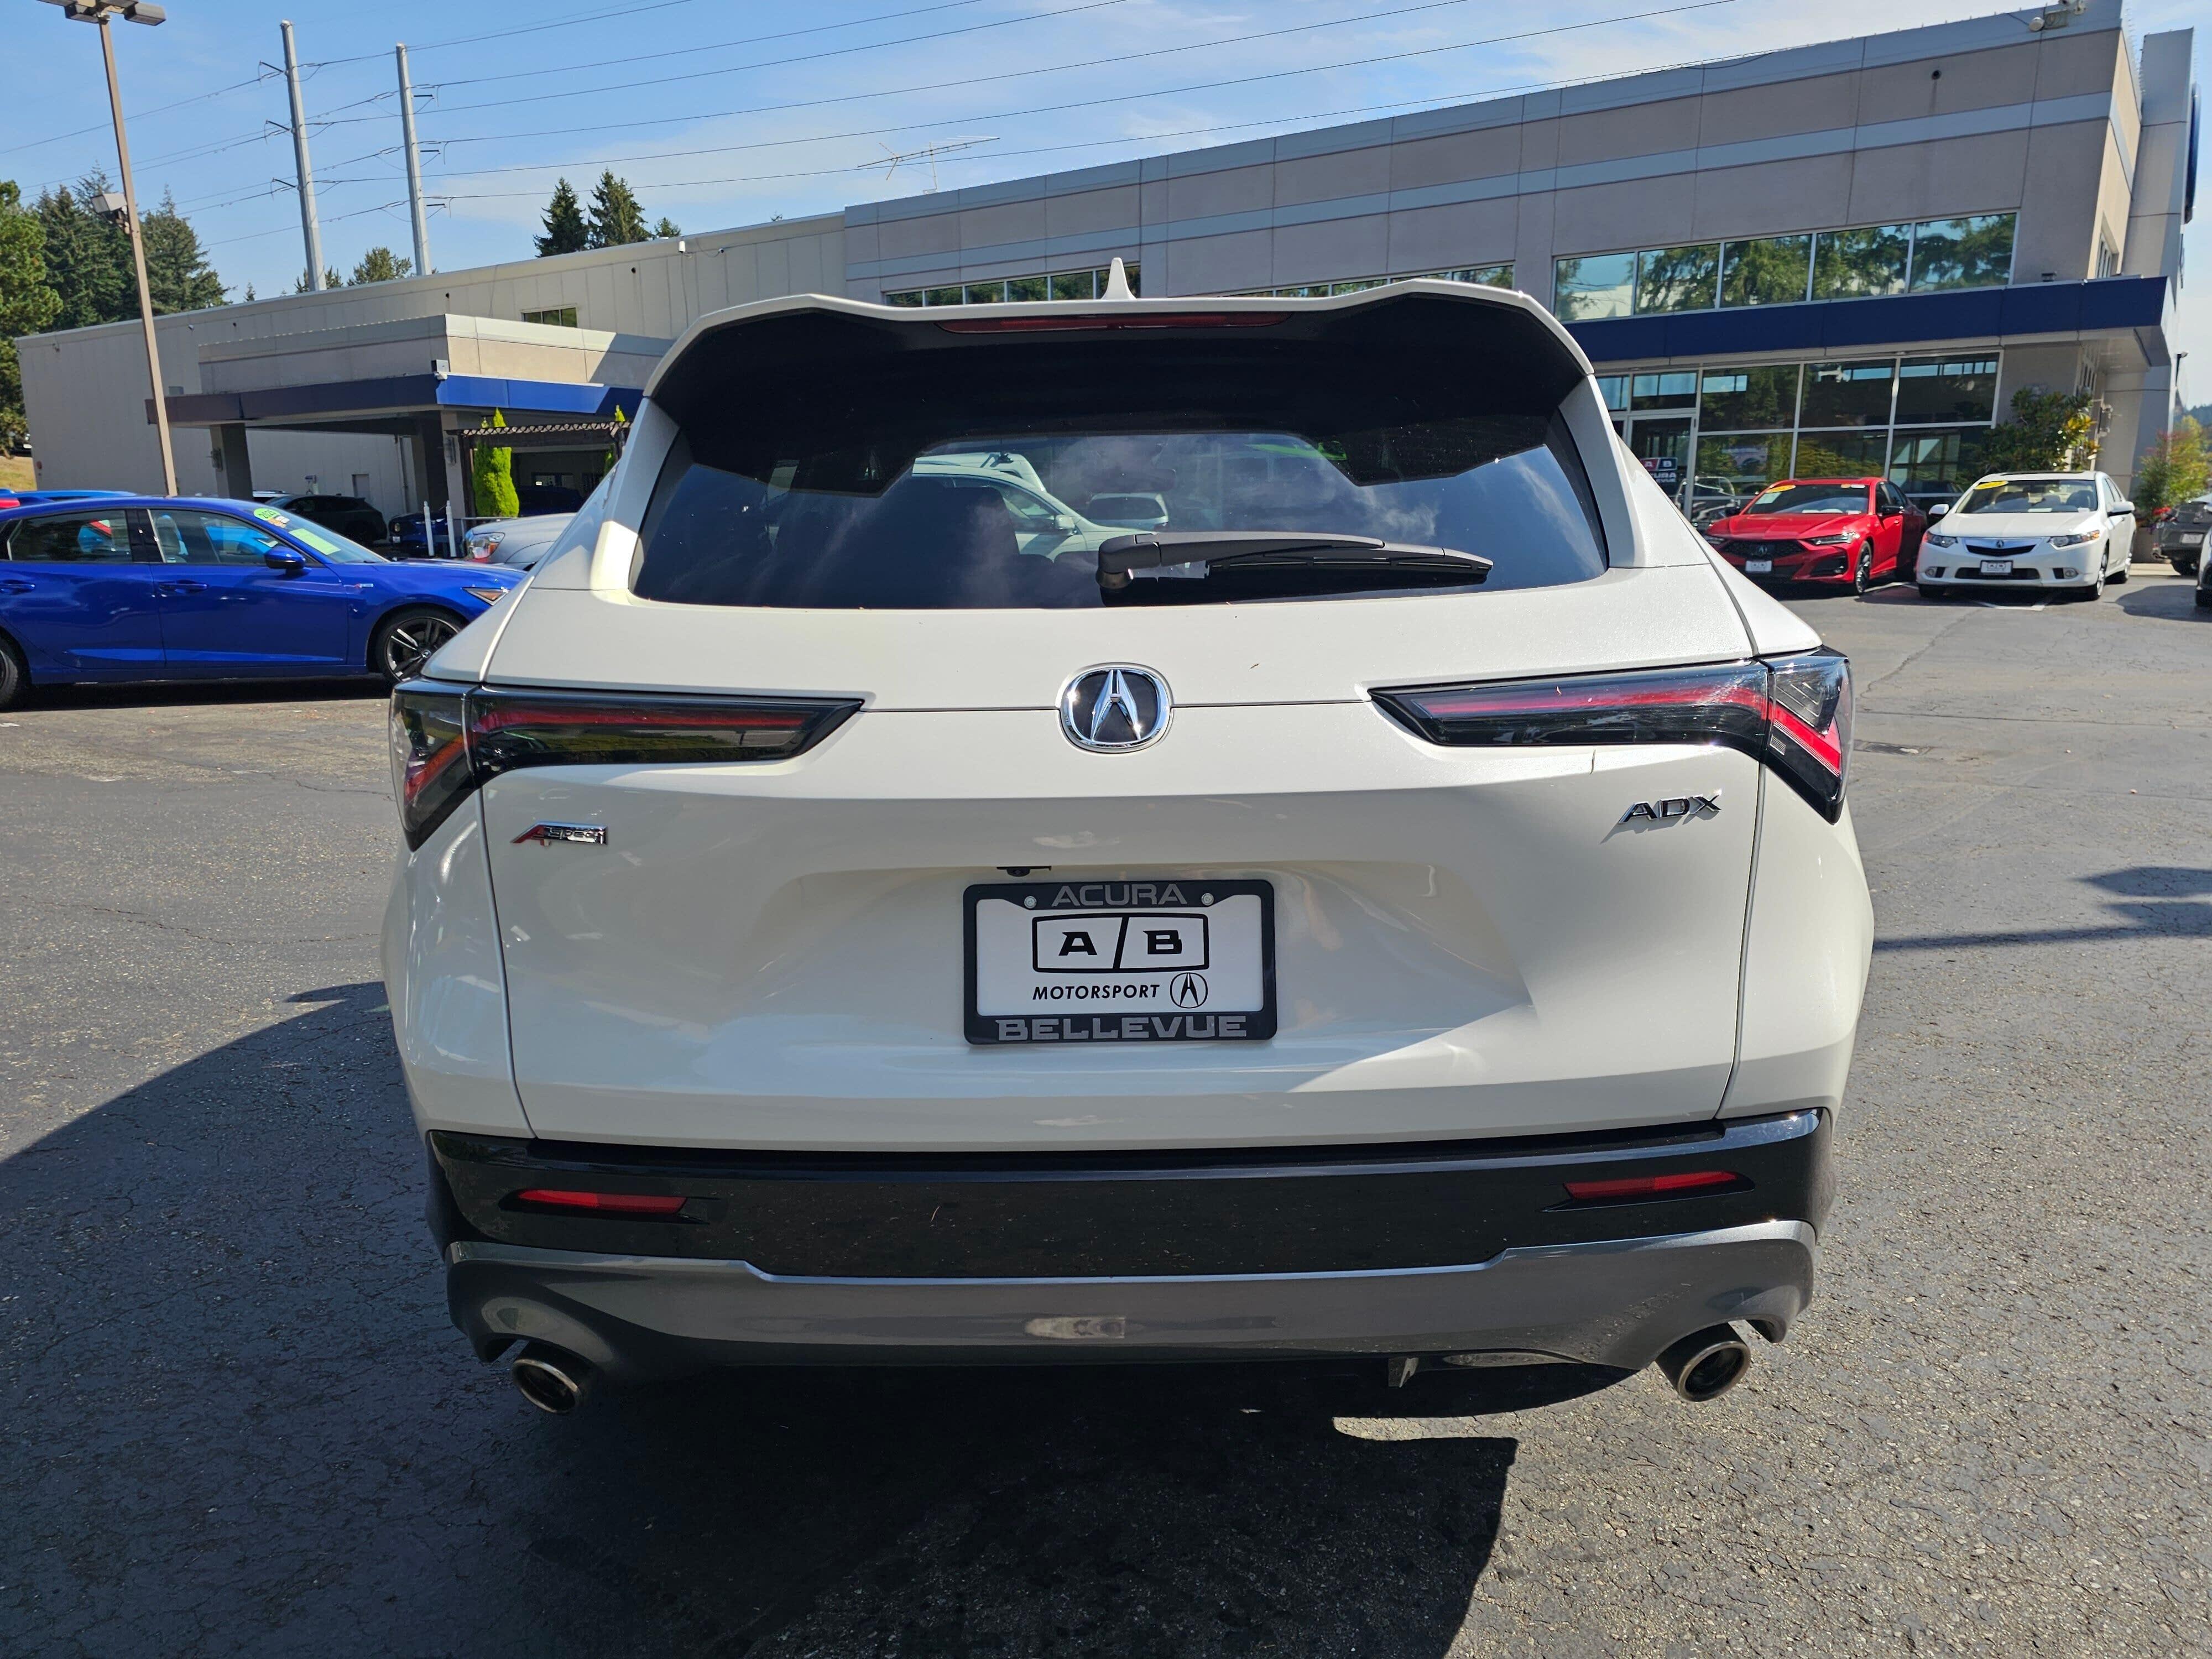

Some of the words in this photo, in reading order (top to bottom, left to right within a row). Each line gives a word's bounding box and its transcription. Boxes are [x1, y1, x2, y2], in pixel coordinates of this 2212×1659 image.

[1618, 789, 1722, 823] ADX
[1051, 884, 1187, 907] ACURA
[1058, 931, 1098, 956] A
[1143, 930, 1183, 955] B
[1032, 984, 1160, 1000] MOTORSPORT
[995, 1015, 1247, 1041] BELLEVUE
